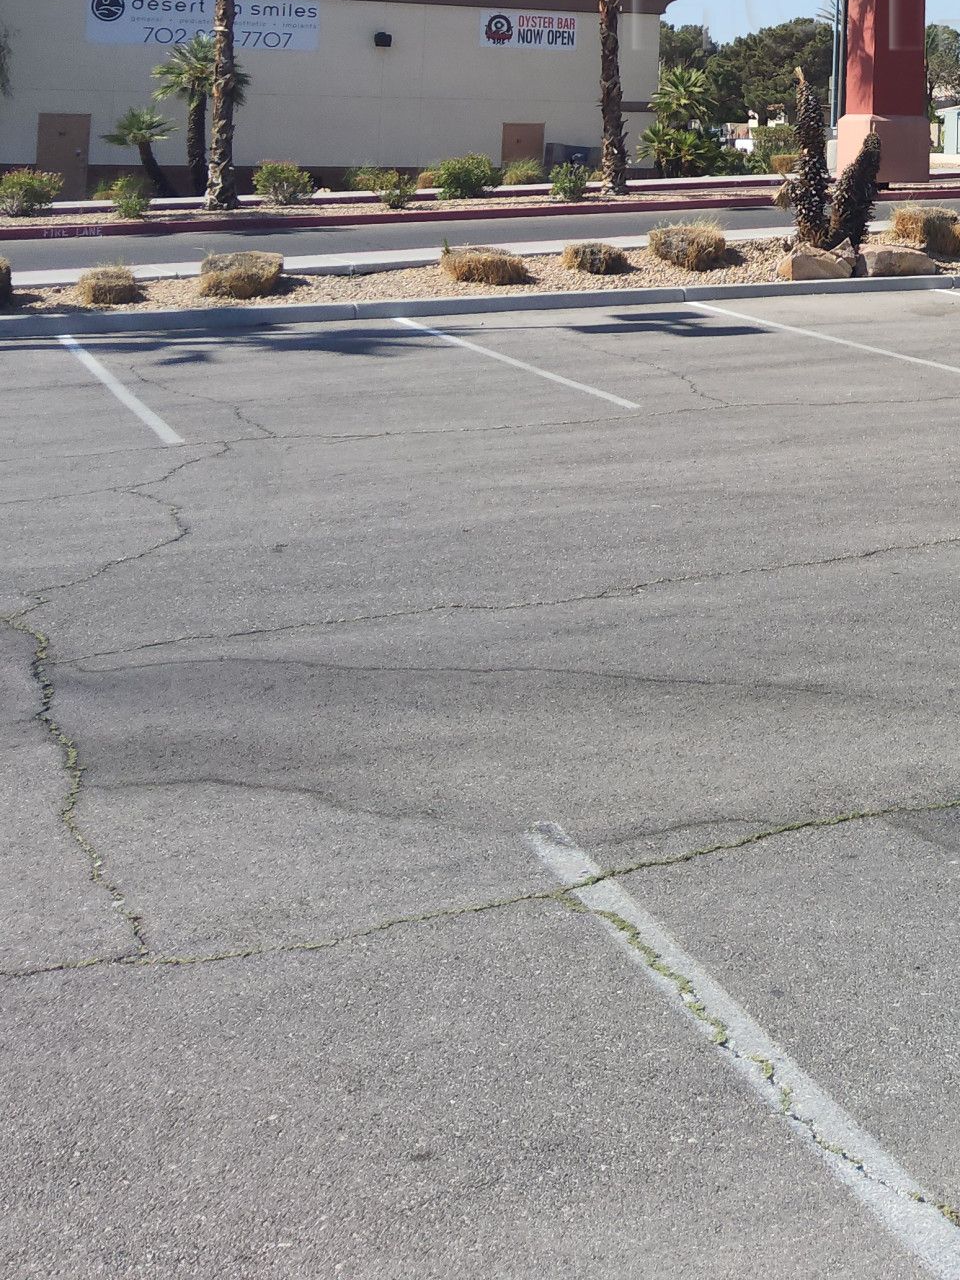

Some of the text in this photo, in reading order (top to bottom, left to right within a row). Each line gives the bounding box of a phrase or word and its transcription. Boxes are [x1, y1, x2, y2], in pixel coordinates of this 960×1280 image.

[250, 2, 318, 18] smiles
[518, 15, 576, 30] OYSTER BAR
[518, 28, 575, 45] NOW OPEN
[43, 226, 103, 237] FIRE LANE
